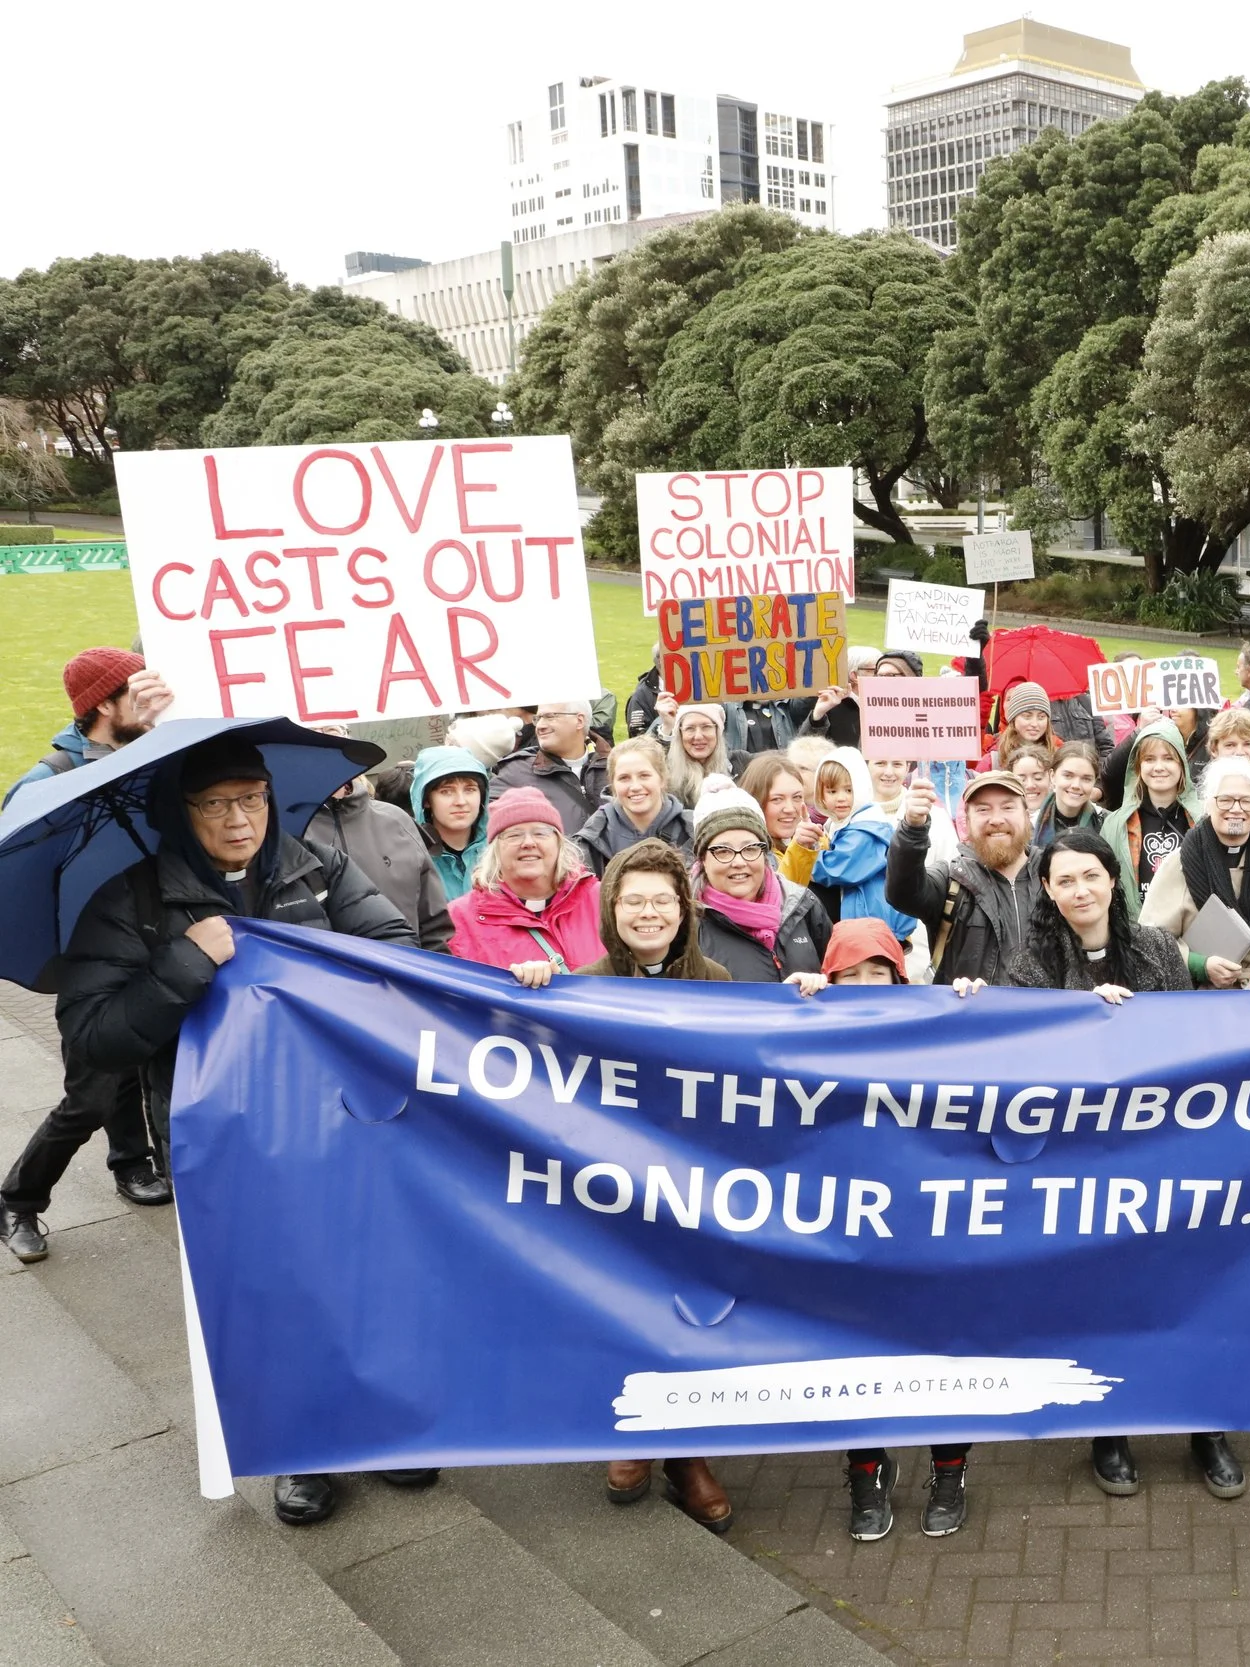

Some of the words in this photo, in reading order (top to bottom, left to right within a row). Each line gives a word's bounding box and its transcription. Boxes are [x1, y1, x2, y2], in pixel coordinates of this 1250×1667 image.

[204, 444, 523, 540] LOVE
[668, 471, 825, 521] STOP
[650, 517, 840, 560] COLONIAL
[152, 546, 395, 621] CASTS
[423, 537, 575, 602] OUT
[645, 556, 854, 612] DOMINATION
[894, 589, 970, 608] STANDING
[659, 592, 839, 651] CELEBRATE
[906, 626, 970, 648] WHENUA
[208, 607, 512, 722] FEAR
[663, 636, 846, 704] DIVERSITY
[1092, 661, 1157, 712] LOVE
[1160, 658, 1205, 671] OVER
[1162, 672, 1220, 707] FEAR
[867, 696, 900, 707] LOVING
[901, 697, 921, 708] OUR
[922, 696, 976, 708] NEIGHBOUR
[868, 726, 929, 738] HONOURING
[932, 726, 944, 738] TE
[946, 726, 977, 738] TIRITI
[415, 1029, 639, 1109] LOVE
[665, 1067, 840, 1127] THY
[506, 1151, 893, 1239] HONOUR
[919, 1178, 1008, 1237] TE
[665, 1388, 792, 1405] COMMON
[803, 1382, 884, 1399] GRACE
[893, 1376, 1011, 1393] AOTEAROA
